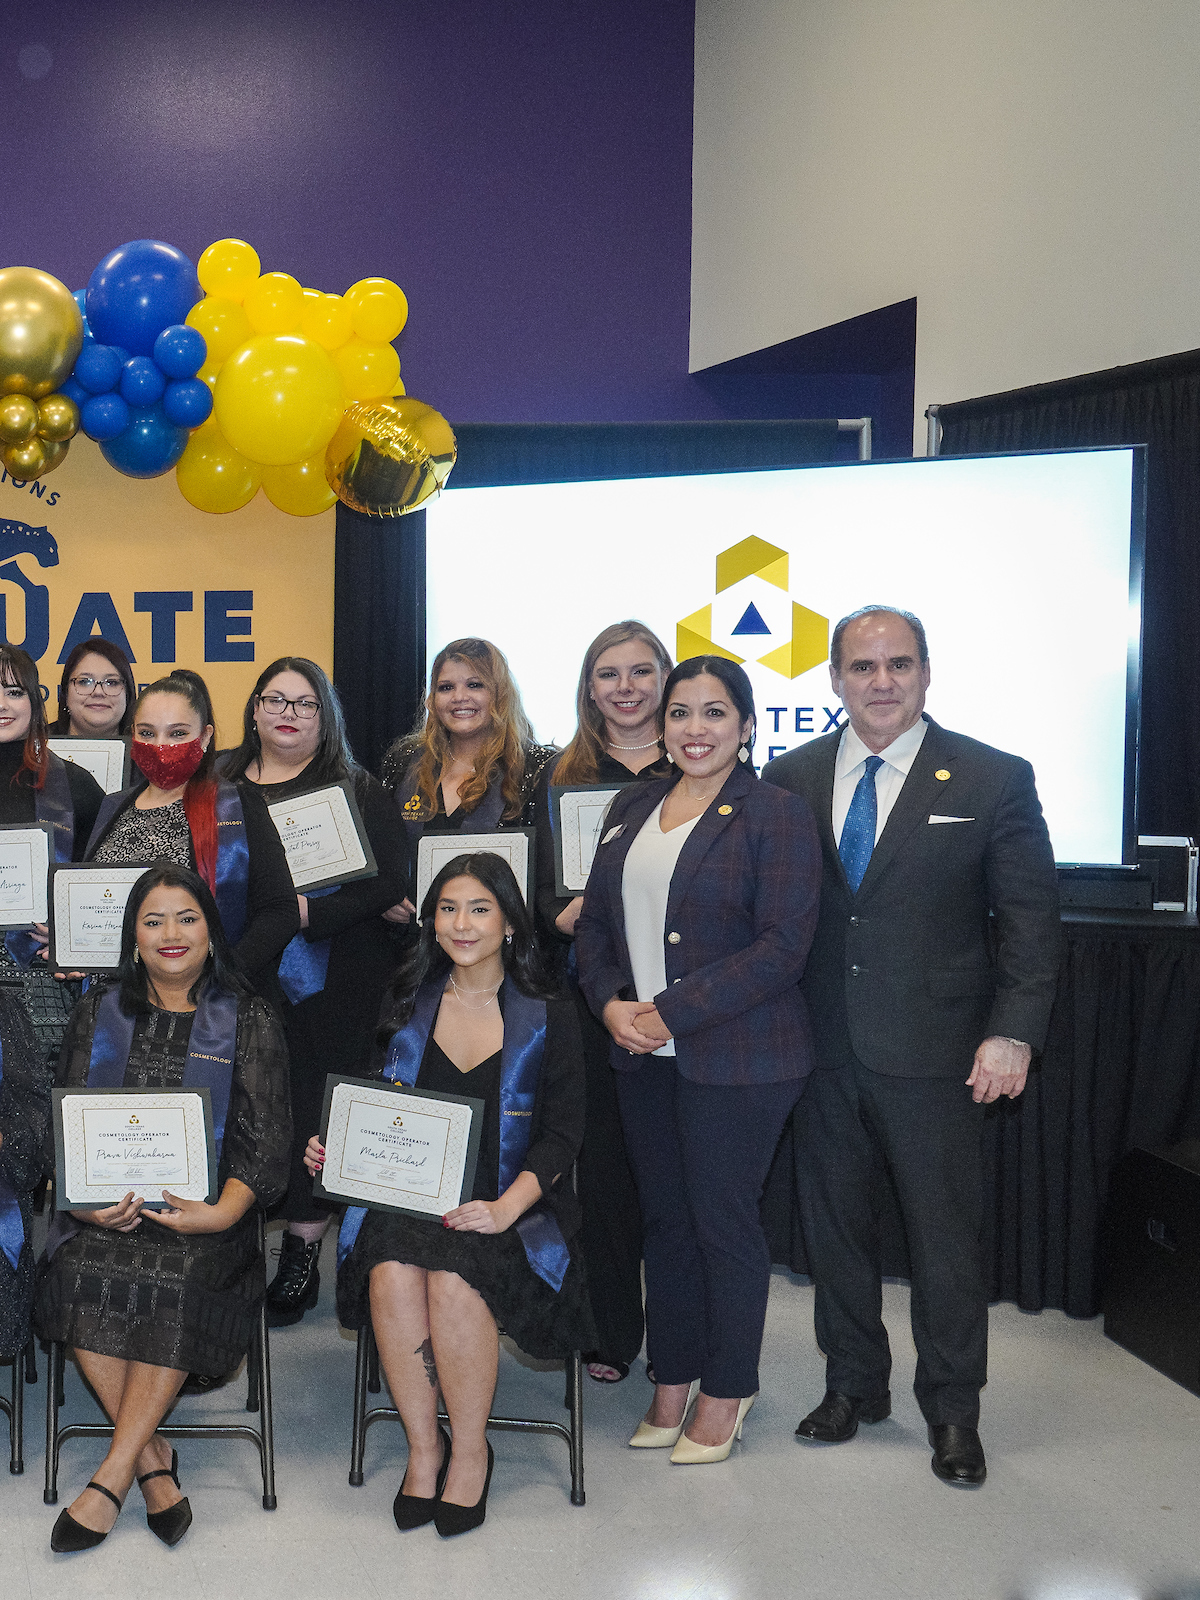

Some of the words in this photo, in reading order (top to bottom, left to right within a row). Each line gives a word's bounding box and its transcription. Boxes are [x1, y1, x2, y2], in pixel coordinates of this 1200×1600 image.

[766, 707, 844, 732] TEX
[283, 832, 308, 842] ERTIFICATE
[190, 1052, 232, 1065] COSMETOLOGY
[360, 1129, 400, 1140] COSMETOLOGY
[402, 1137, 430, 1146] OPERATOR
[378, 1137, 412, 1147] CERTIFICATE
